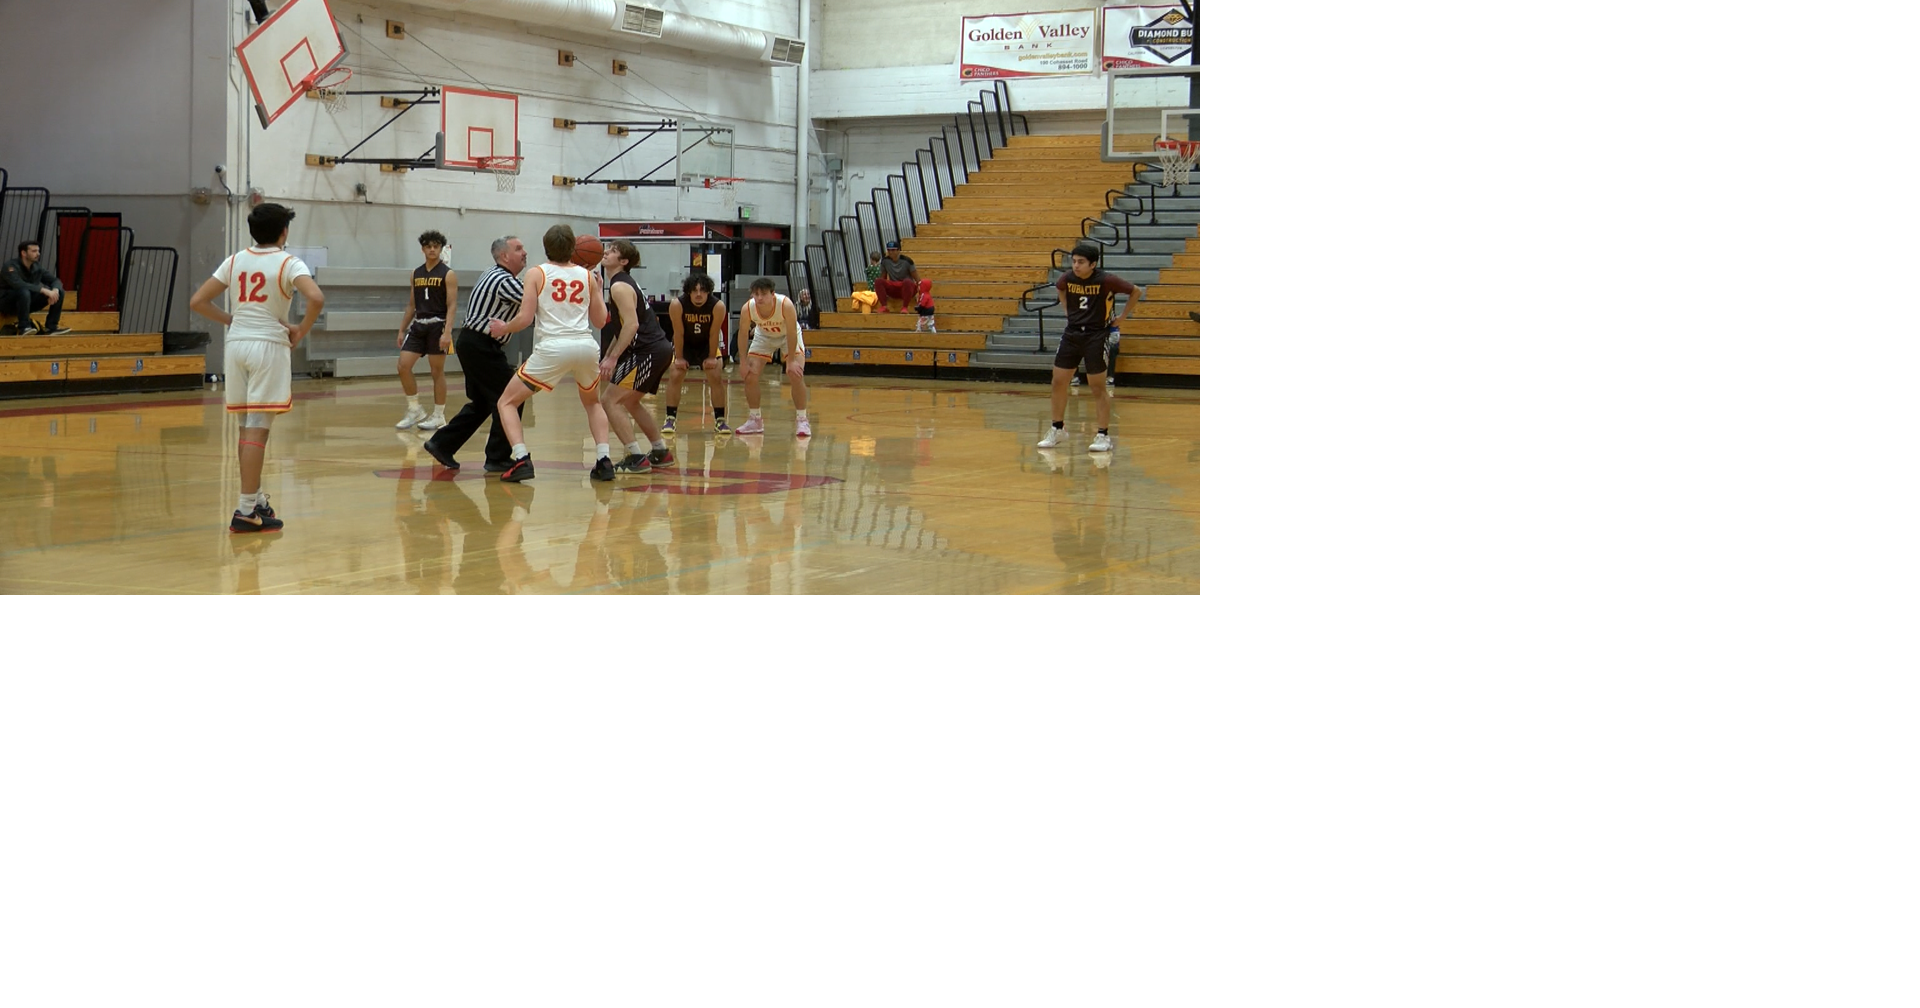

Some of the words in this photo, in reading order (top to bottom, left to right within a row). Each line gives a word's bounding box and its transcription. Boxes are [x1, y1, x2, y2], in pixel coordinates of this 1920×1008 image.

[968, 28, 1023, 41] Golden
[1038, 23, 1090, 38] Valley
[1138, 29, 1179, 38] DIAMOND
[1018, 51, 1088, 61] goldenvalleybank.com
[238, 271, 269, 303] 12
[428, 277, 442, 286] CITY
[1067, 282, 1084, 294] YUBA
[1085, 284, 1100, 294] CITY
[424, 287, 429, 300] 1
[551, 278, 584, 304] 32
[1079, 296, 1088, 309] 2
